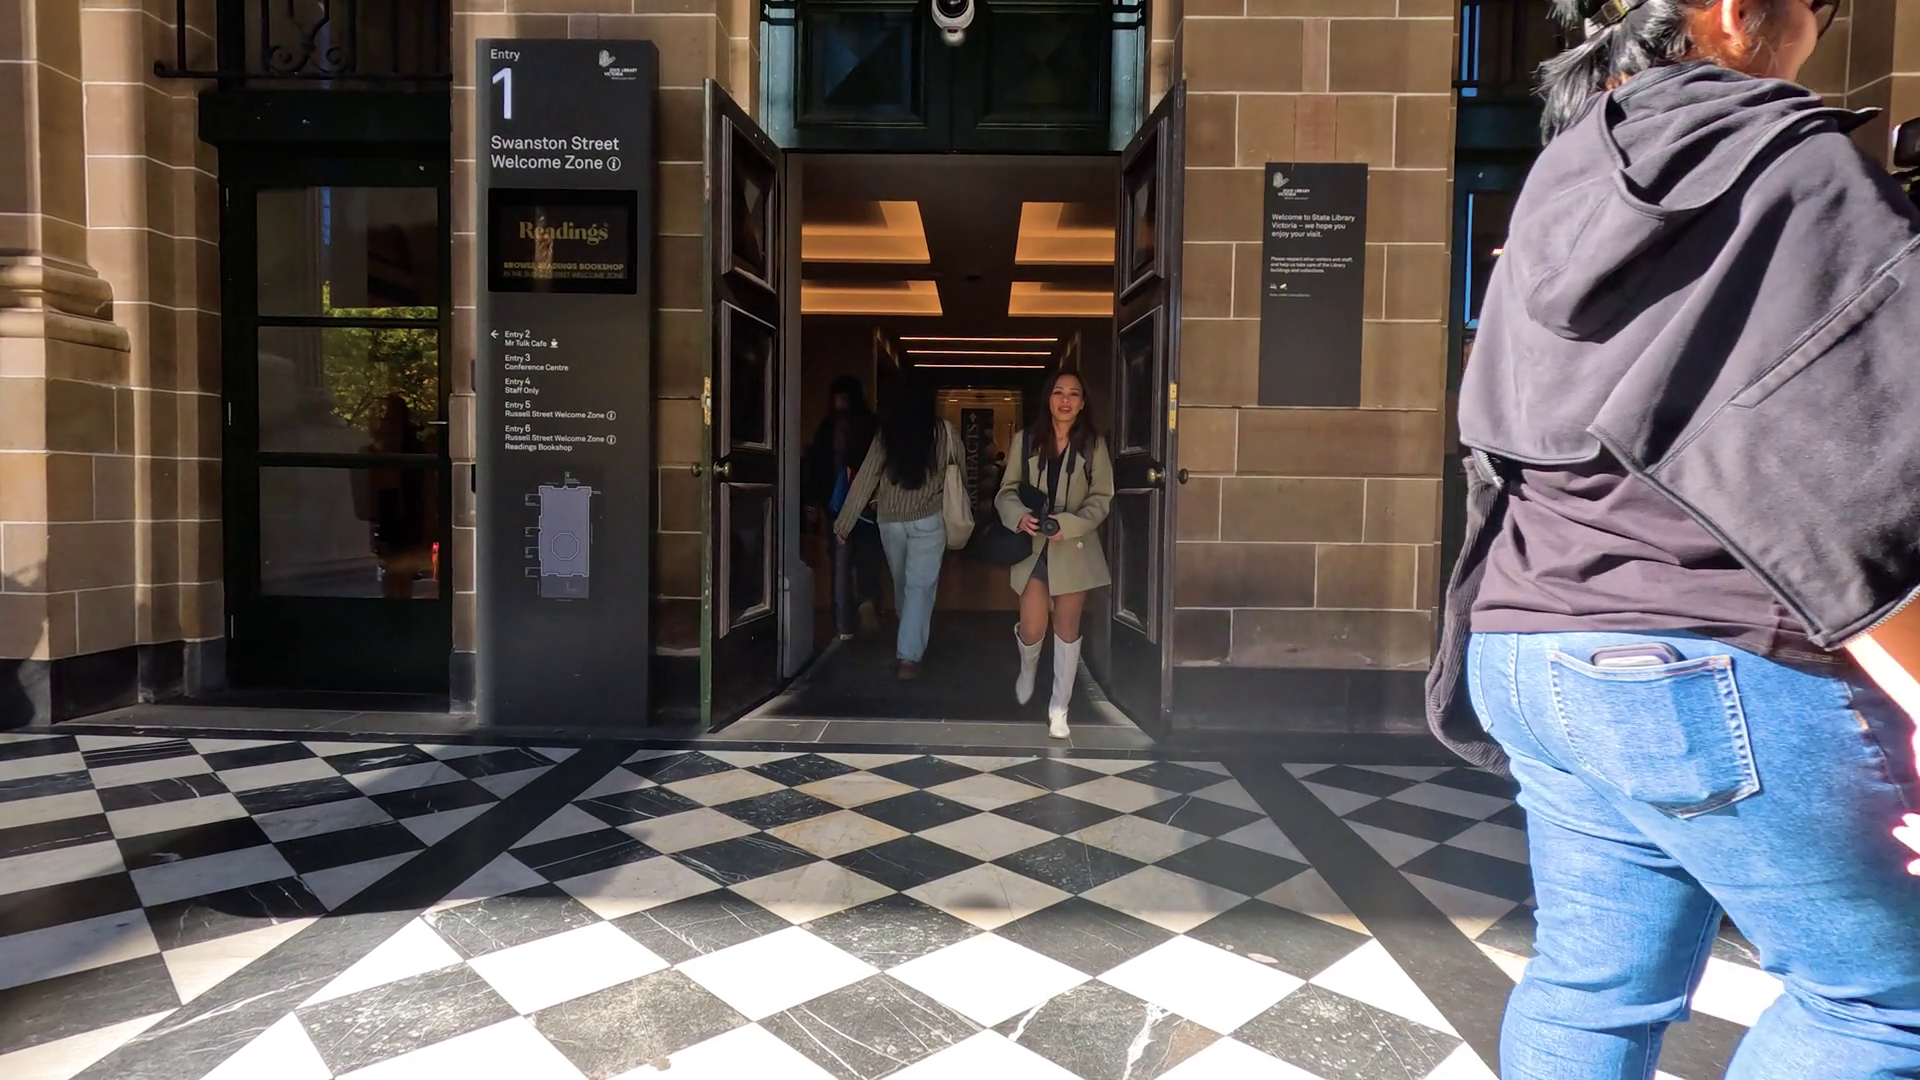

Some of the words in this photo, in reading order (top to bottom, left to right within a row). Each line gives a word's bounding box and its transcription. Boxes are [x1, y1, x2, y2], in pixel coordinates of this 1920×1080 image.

[490, 49, 520, 62] Entry
[492, 67, 512, 120] 1
[490, 135, 567, 150] Swanston
[571, 136, 619, 151] Street
[490, 154, 561, 169] Welcome
[565, 155, 603, 169] Zone
[1331, 214, 1356, 223] Library
[519, 221, 609, 246] Readings
[579, 263, 624, 271] BOOKSHOP
[504, 330, 523, 339] Entry
[525, 329, 531, 338] 2
[504, 354, 524, 363] Entry
[525, 353, 531, 362] 3
[504, 363, 545, 371] Conference
[504, 378, 524, 386] Entry
[525, 377, 531, 385] 4
[504, 386, 523, 394] Staff
[523, 387, 540, 395] Only
[505, 401, 524, 409] Entry
[525, 400, 531, 409] 5
[532, 410, 553, 418] Street
[505, 425, 524, 433] Entry
[525, 424, 531, 432] 6
[532, 434, 553, 442] Street
[587, 435, 605, 443] Zone
[505, 443, 537, 452] Readings
[538, 443, 573, 452] Bookshop
